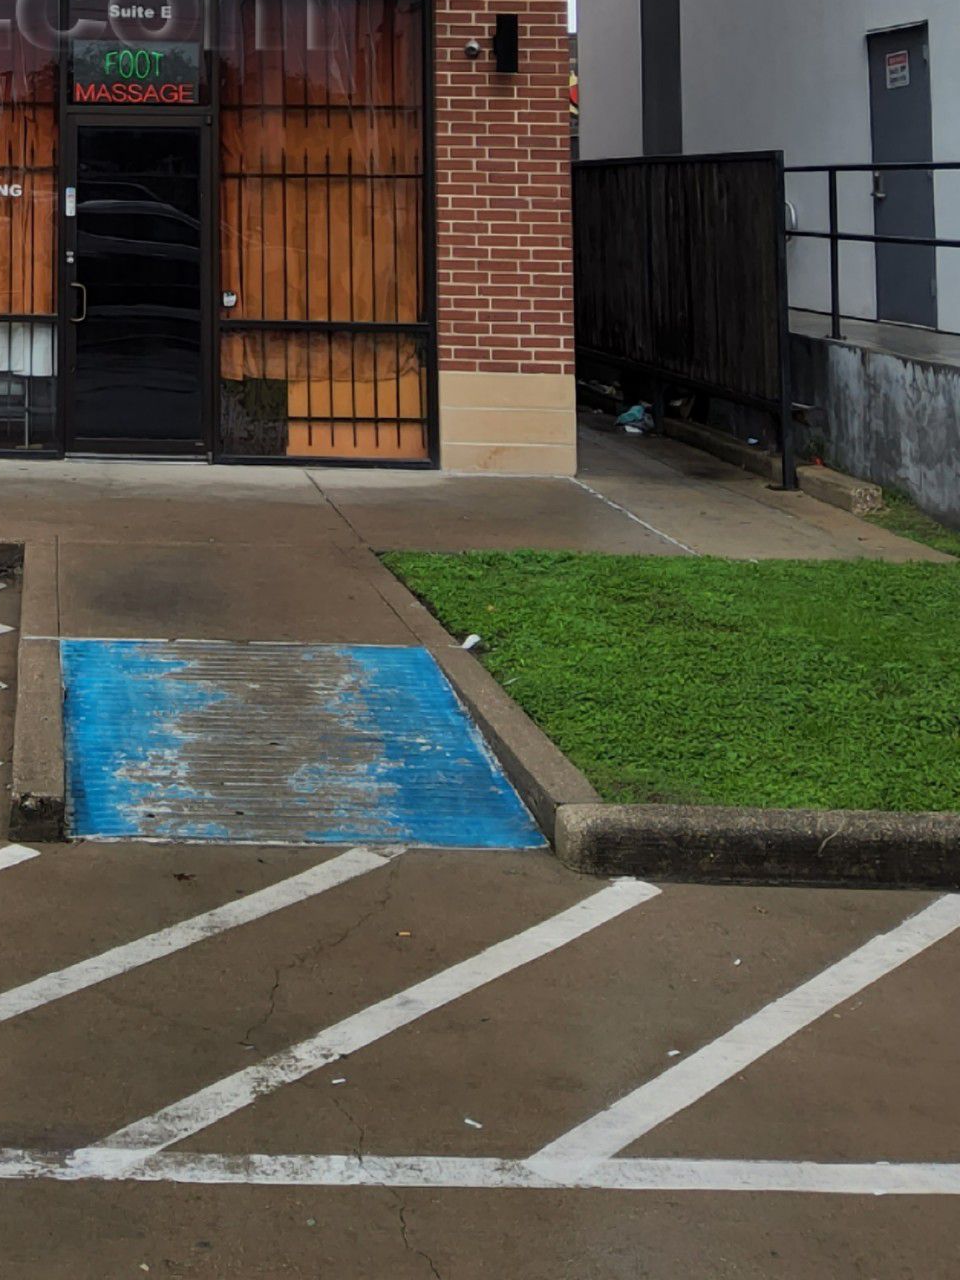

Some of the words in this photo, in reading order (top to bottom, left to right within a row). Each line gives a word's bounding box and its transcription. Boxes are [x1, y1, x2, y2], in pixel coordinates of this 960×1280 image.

[109, 5, 155, 19] Suite
[161, 6, 172, 19] E
[104, 50, 164, 79] FOOT
[74, 82, 194, 103] MASSAGE
